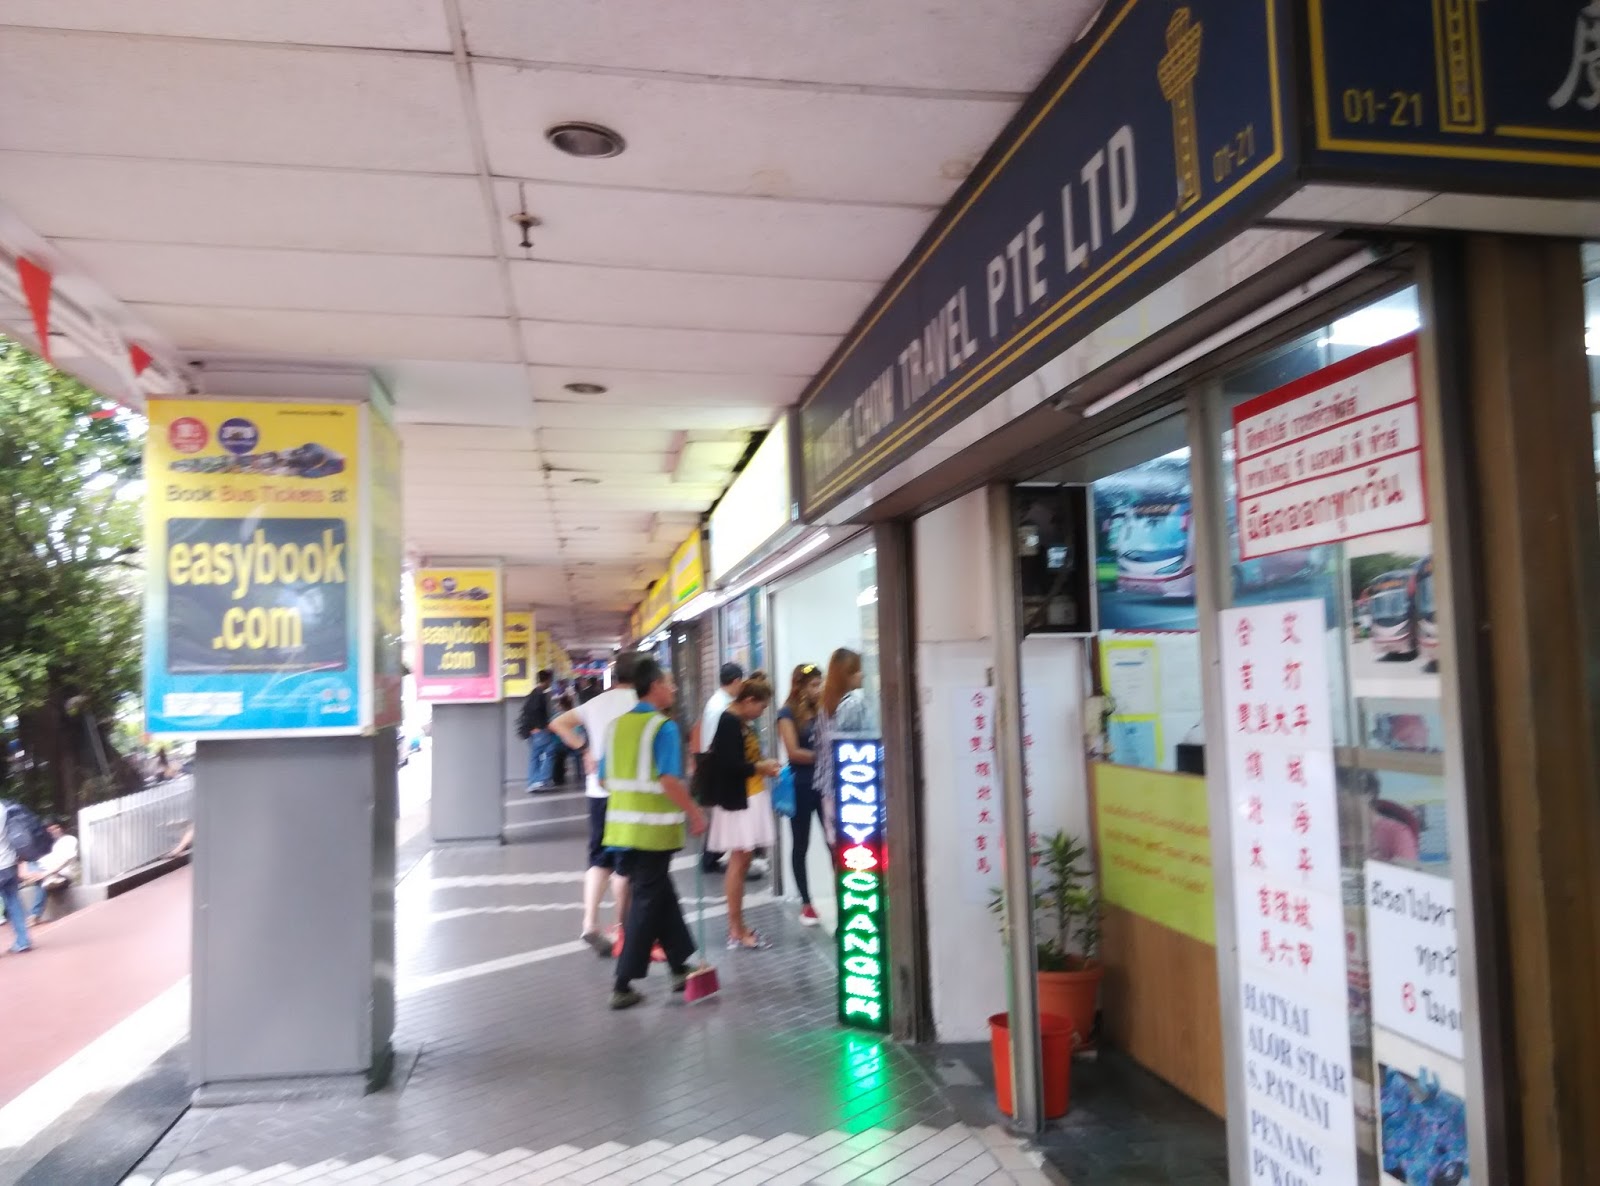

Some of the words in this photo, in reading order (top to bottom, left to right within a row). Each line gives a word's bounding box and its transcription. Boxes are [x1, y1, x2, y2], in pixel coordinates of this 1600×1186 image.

[1343, 88, 1423, 127] 01-21
[897, 284, 978, 411] TRAVEL
[986, 210, 1048, 338] PTE
[1061, 124, 1138, 274] LTD
[167, 484, 215, 502] Book
[220, 485, 255, 502] Bus
[330, 487, 347, 503] at
[168, 528, 346, 600] easybook
[212, 606, 304, 650] .com
[838, 743, 878, 844] MONEY
[841, 871, 881, 1020] CHANGER
[1244, 983, 1310, 1036] HATYAI
[1249, 1025, 1293, 1069] ALOR
[1297, 1046, 1348, 1097] STAR
[1251, 1109, 1322, 1176] PENANG
